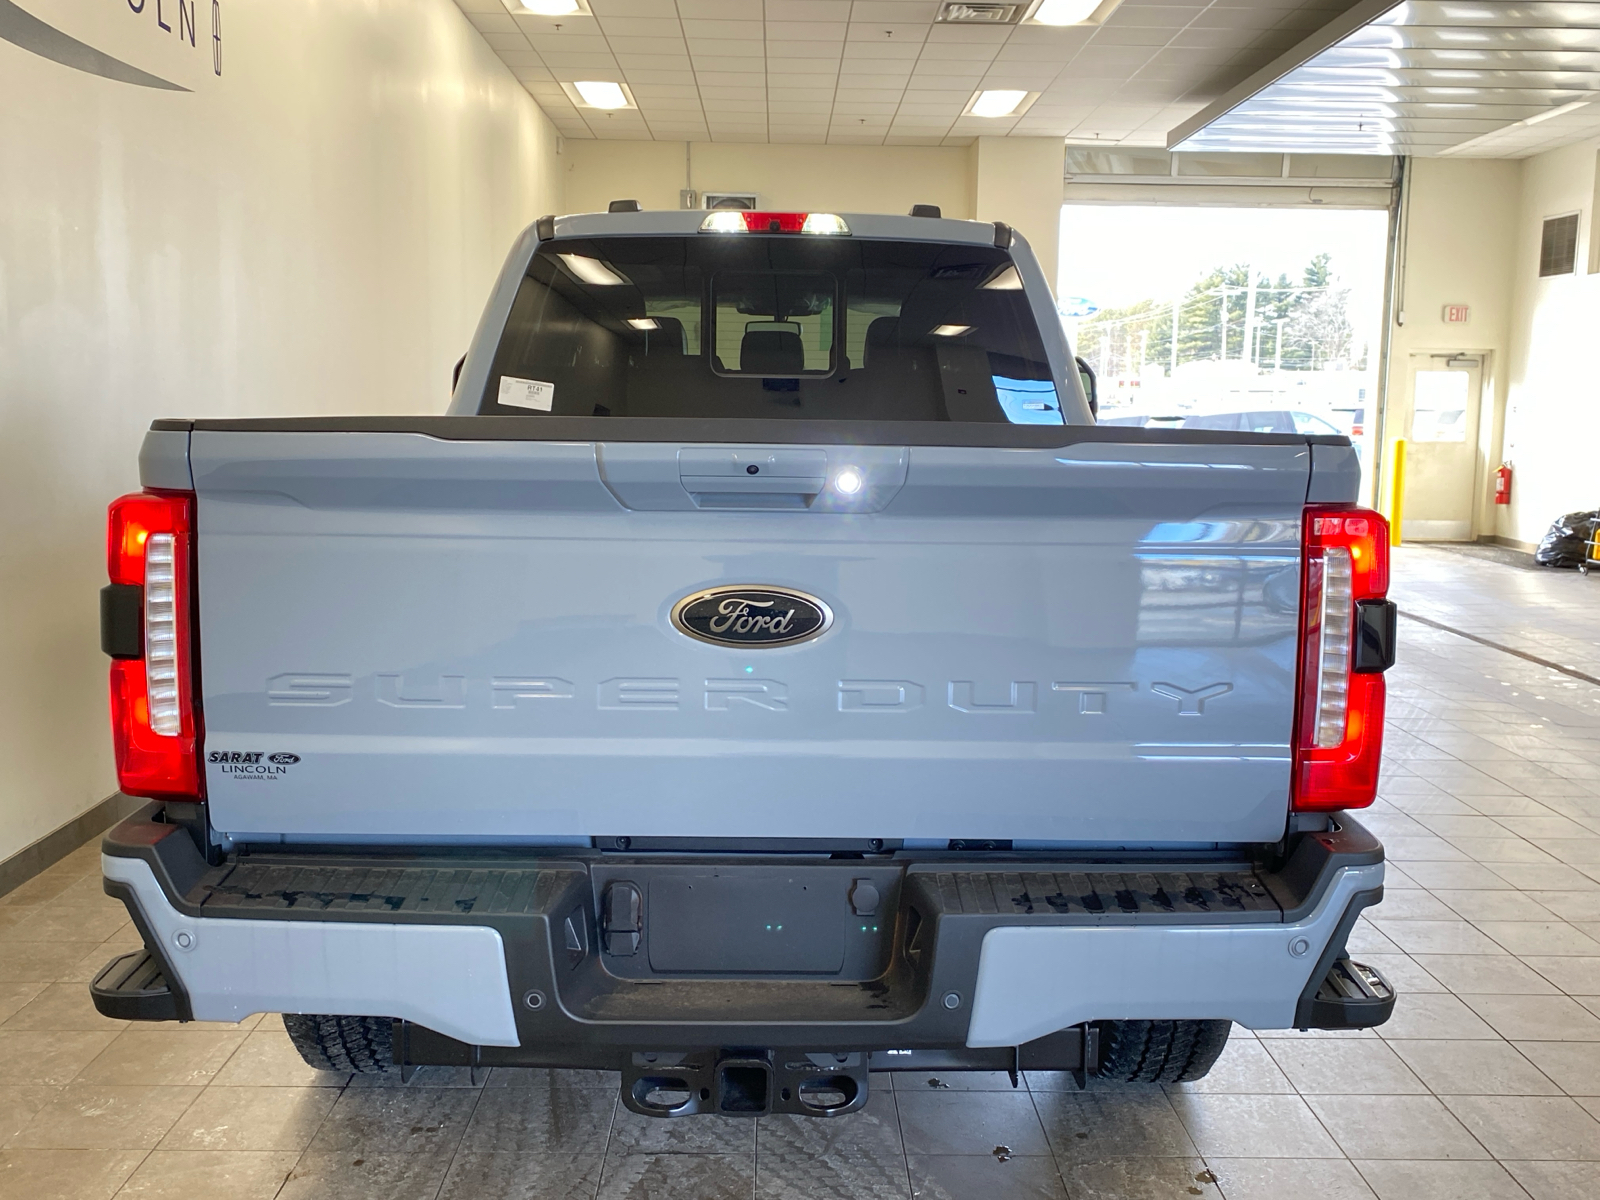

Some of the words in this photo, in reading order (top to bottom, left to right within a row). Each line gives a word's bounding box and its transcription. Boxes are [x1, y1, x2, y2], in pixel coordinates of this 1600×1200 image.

[1449, 306, 1469, 322] EXIT
[709, 598, 796, 634] Ford
[267, 673, 789, 711] SUPER
[837, 680, 1234, 716] DUTY
[208, 751, 264, 764] SARAT
[273, 755, 294, 763] Ford
[222, 765, 286, 774] LINCOLN
